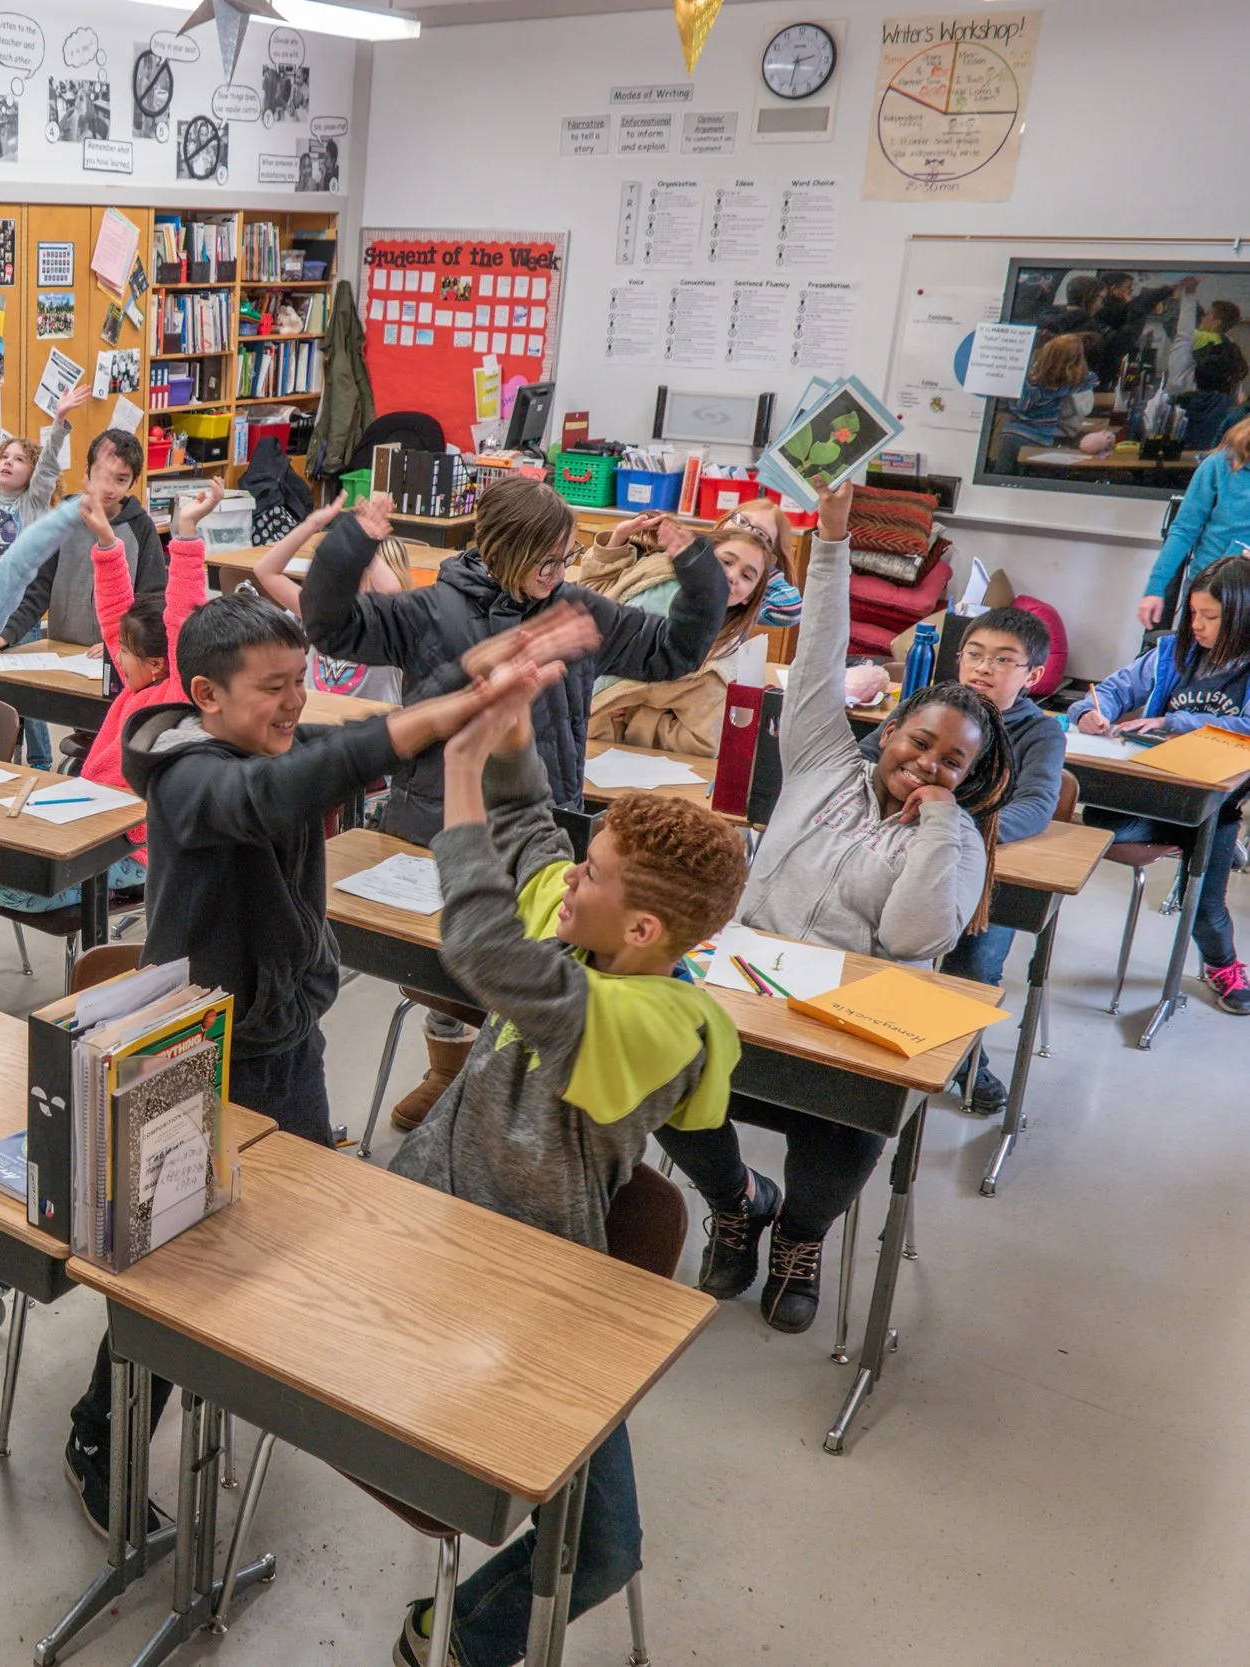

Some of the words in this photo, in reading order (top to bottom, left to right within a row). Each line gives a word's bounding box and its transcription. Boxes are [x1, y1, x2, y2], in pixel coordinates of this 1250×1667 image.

[882, 23, 934, 45] Writer's
[940, 16, 1026, 47] Workshop!
[614, 91, 641, 100] Modes
[643, 90, 653, 99] of
[656, 89, 690, 101] Writing
[637, 129, 663, 139] inform
[574, 146, 594, 154] story
[621, 143, 636, 151] and
[638, 143, 665, 152] explain
[735, 179, 754, 188] Ideas
[362, 246, 437, 269] Student
[442, 246, 463, 265] of
[470, 247, 503, 267] the
[510, 247, 561, 271] Week
